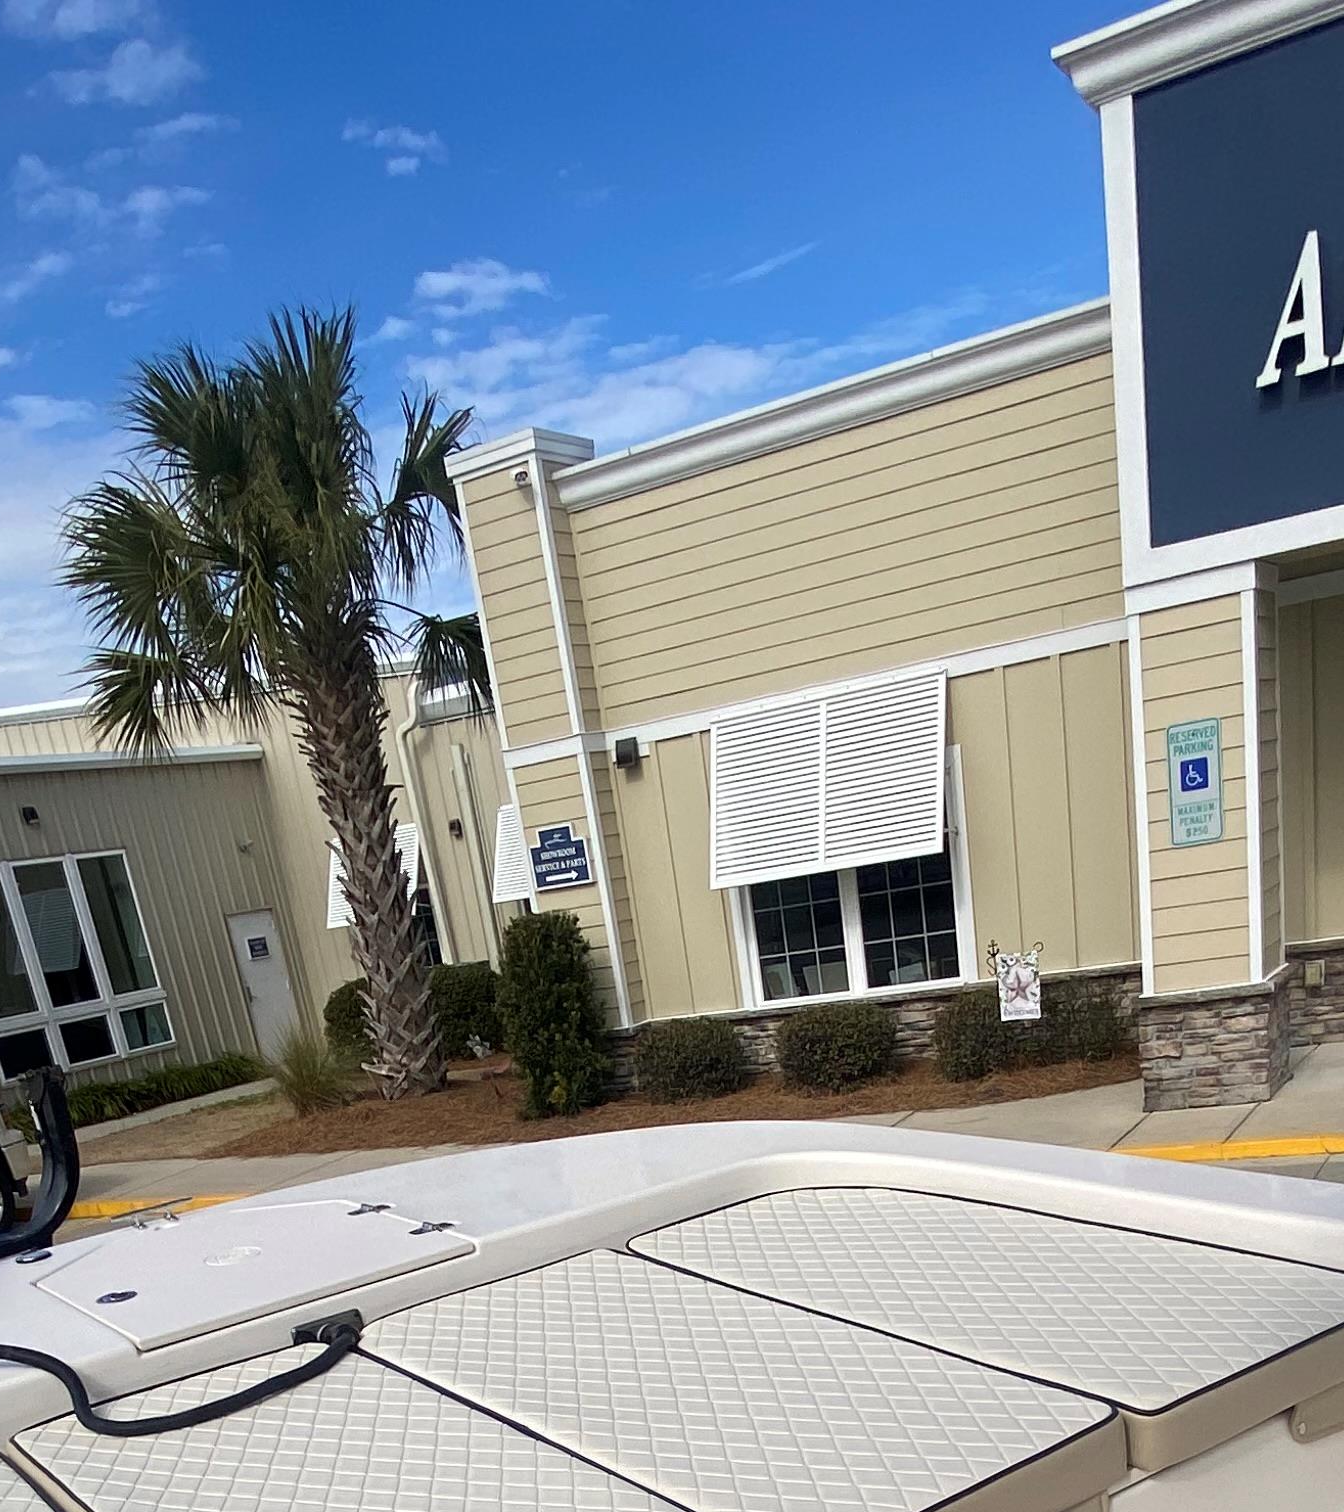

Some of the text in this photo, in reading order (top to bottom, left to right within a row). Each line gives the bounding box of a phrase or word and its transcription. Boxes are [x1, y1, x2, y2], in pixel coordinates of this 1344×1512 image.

[1169, 726, 1216, 744] RESERVED
[1173, 740, 1214, 757] PARKING
[1177, 802, 1214, 816] MAXIMUM
[1179, 813, 1213, 827] PENALTY
